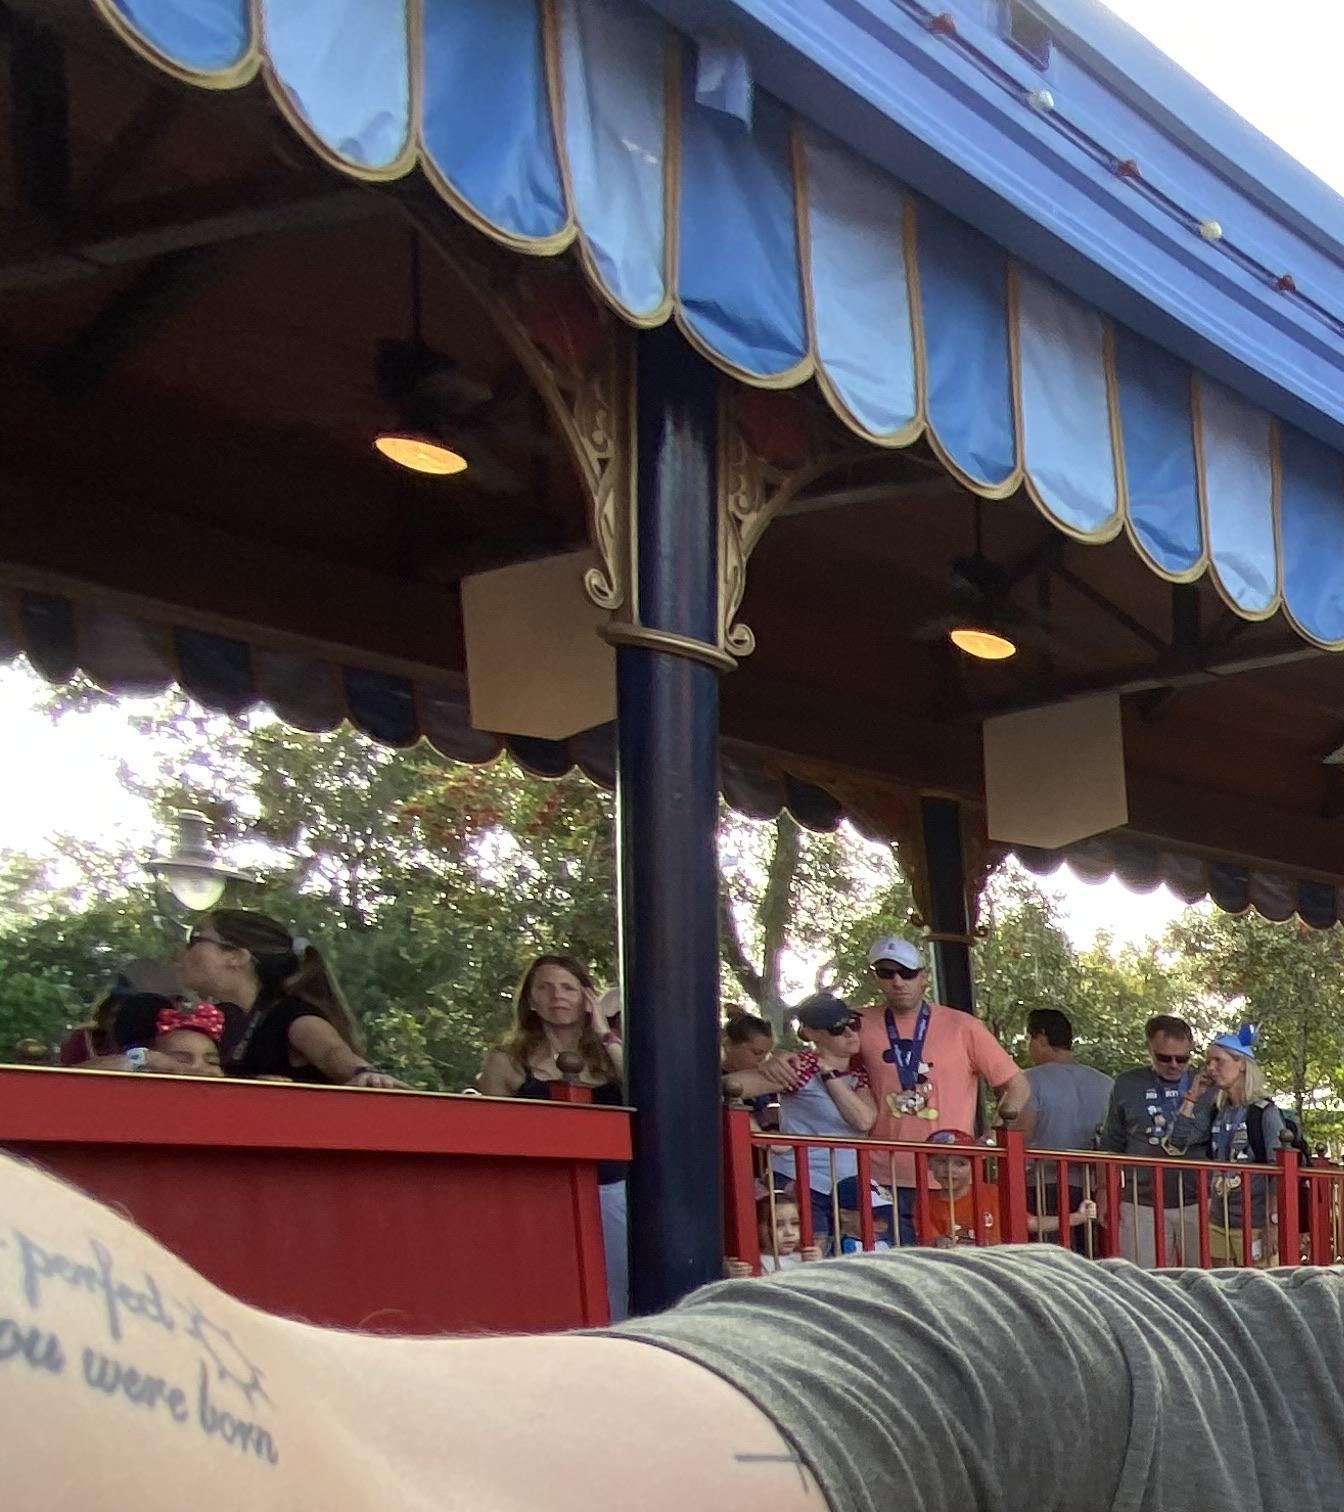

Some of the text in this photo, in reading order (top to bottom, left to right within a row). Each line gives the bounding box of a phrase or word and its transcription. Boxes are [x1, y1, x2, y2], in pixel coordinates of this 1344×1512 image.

[0, 1317, 279, 1465] ou were born
